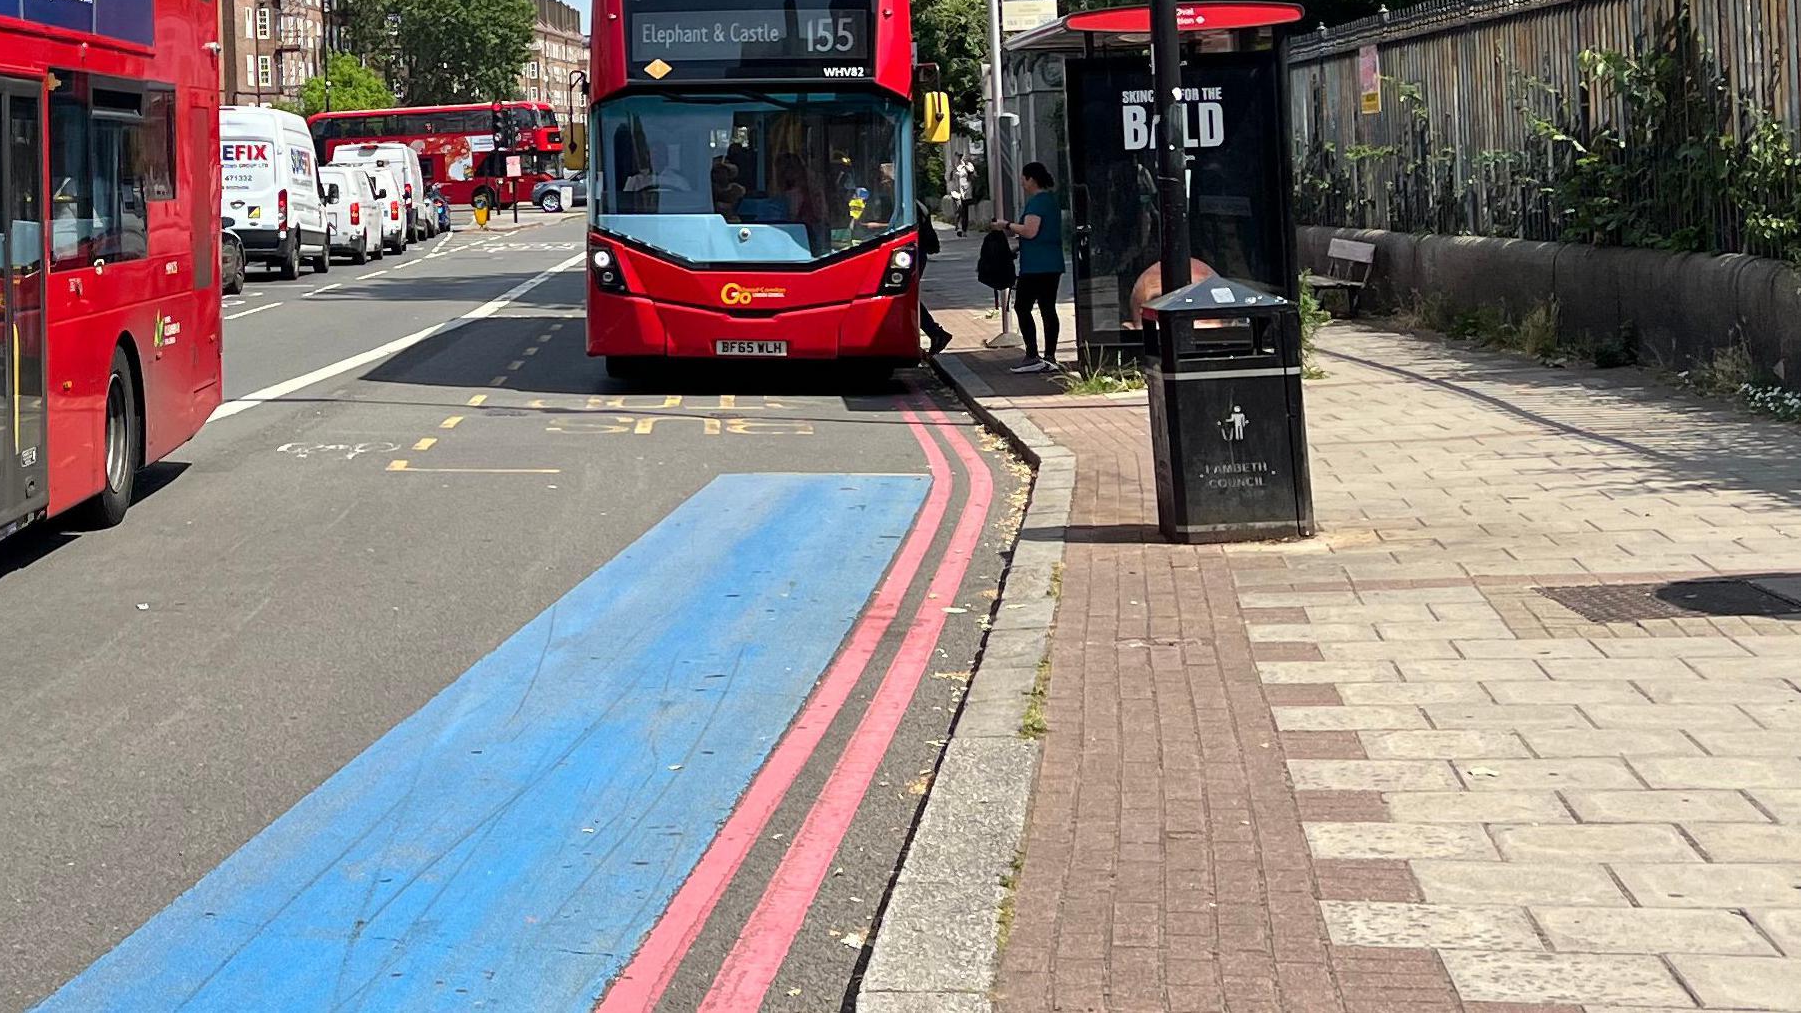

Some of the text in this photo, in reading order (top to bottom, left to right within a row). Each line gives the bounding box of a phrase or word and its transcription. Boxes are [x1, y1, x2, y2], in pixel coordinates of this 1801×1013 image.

[642, 23, 780, 49] Elephant & Castle
[806, 18, 854, 52] 155
[823, 66, 865, 77] WHV82
[1201, 87, 1223, 100] THE
[721, 342, 783, 354] BF65 WLH
[1208, 476, 1265, 489] COUNCIL
